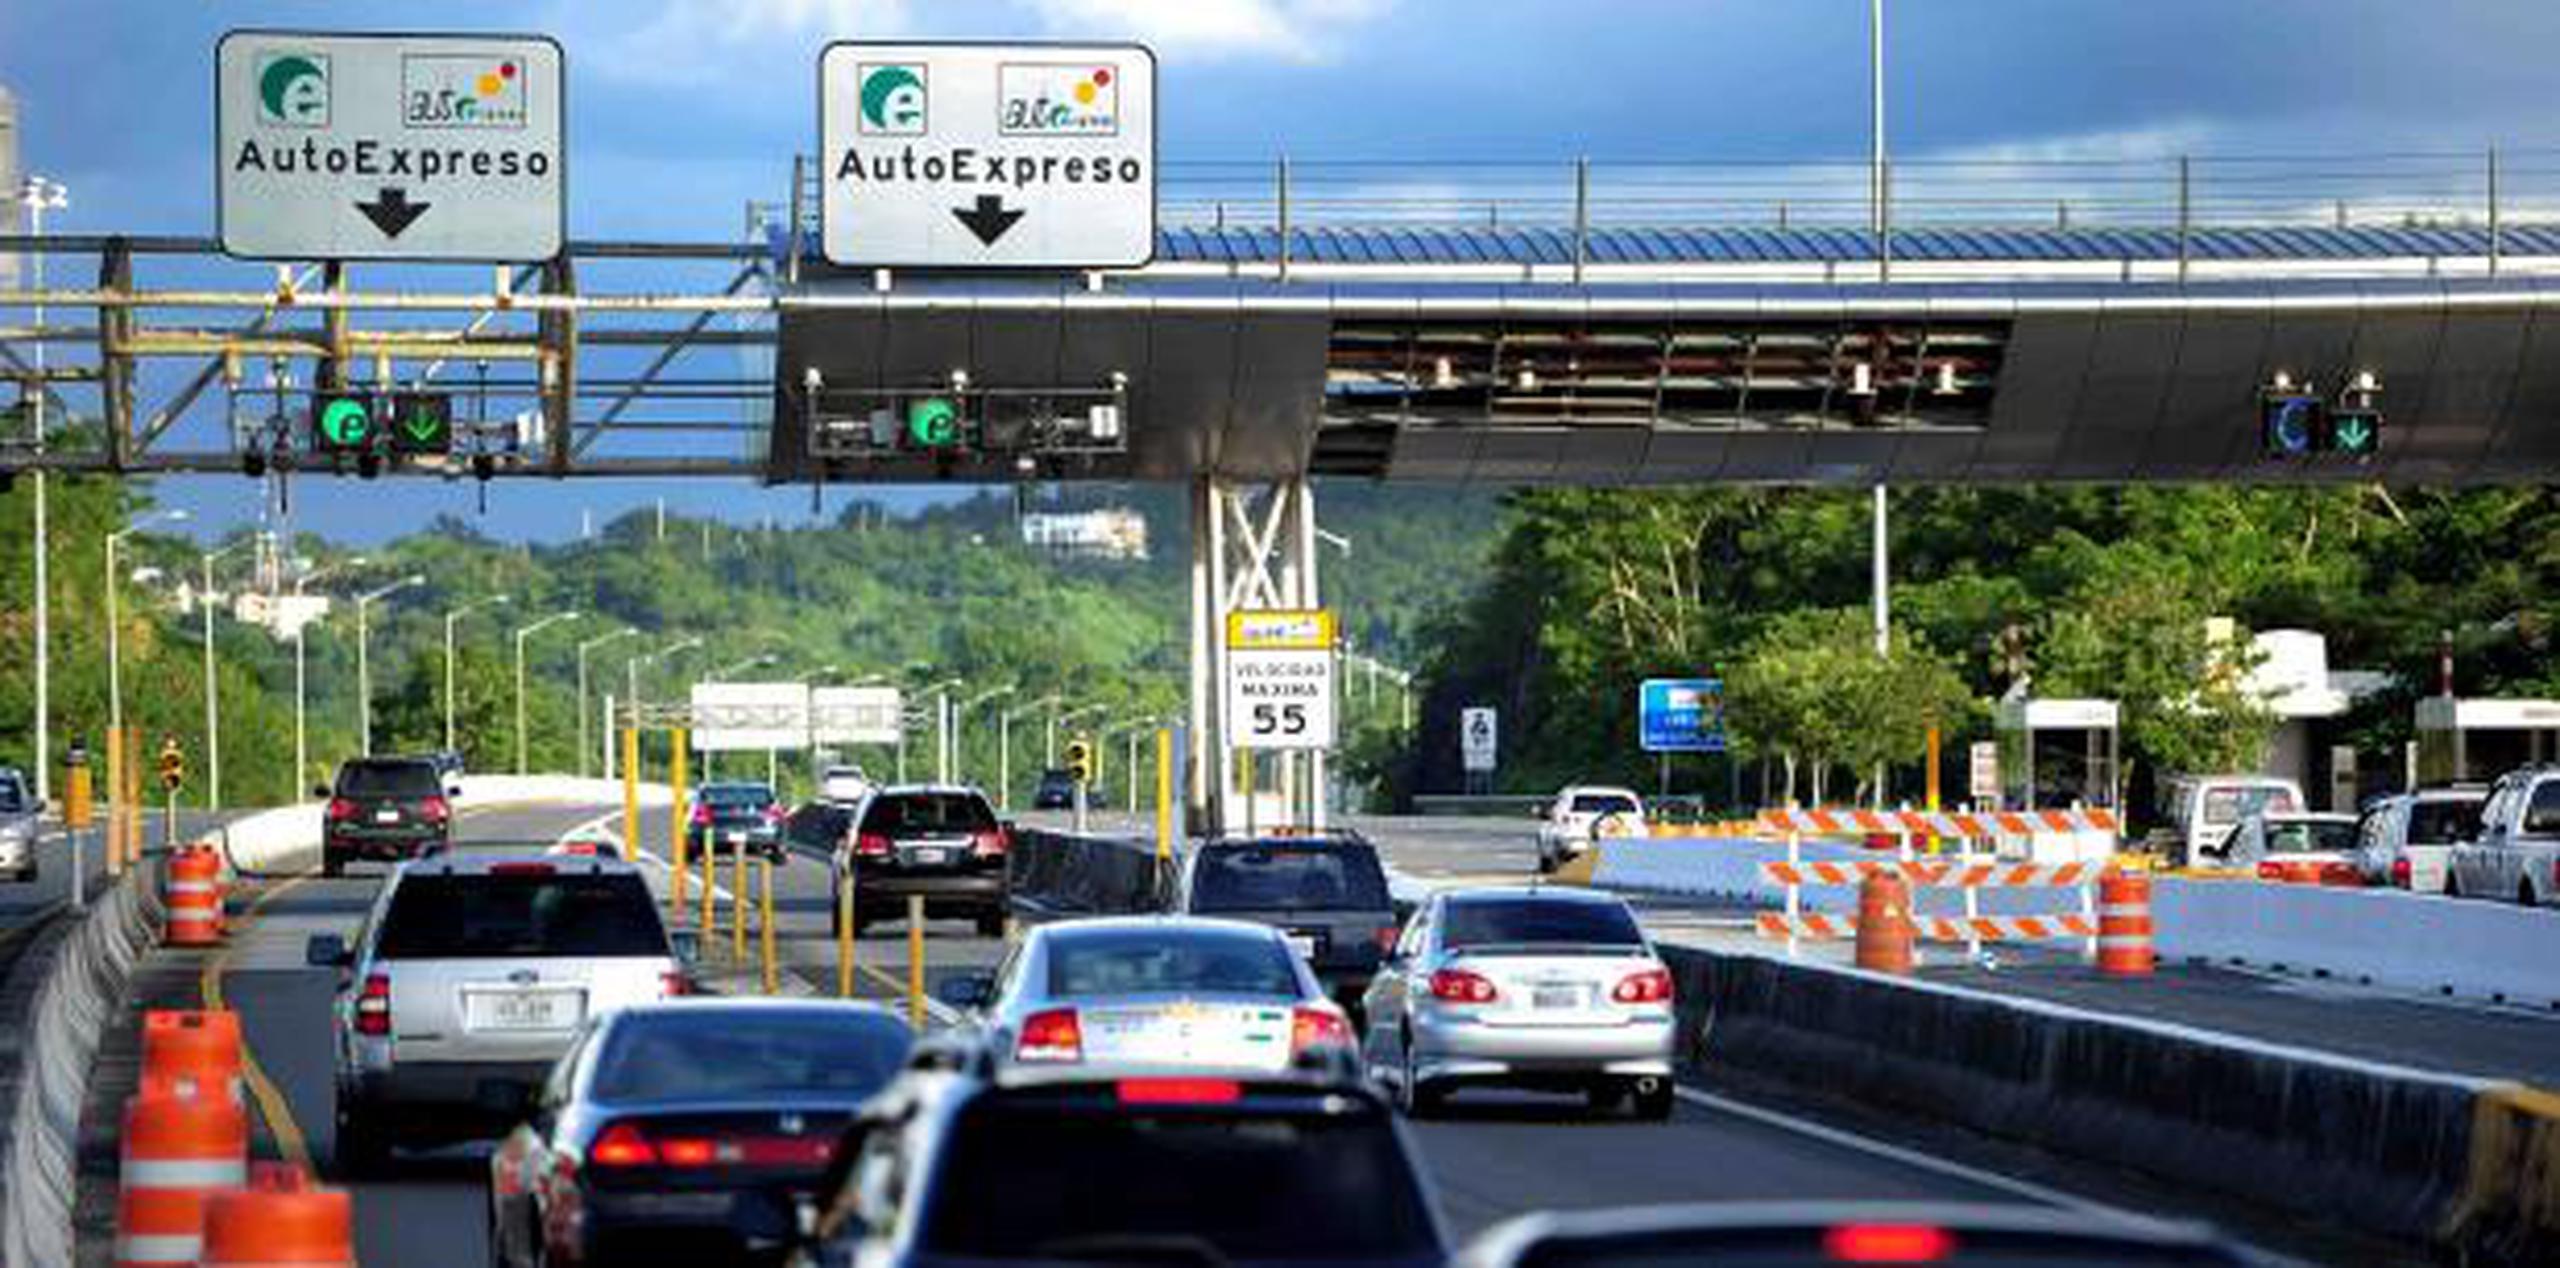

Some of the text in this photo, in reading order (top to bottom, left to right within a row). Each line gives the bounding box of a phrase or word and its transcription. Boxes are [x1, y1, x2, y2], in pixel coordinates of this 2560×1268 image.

[235, 136, 549, 182] AutoExpreso
[837, 146, 1141, 189] AutoExpreso
[1235, 662, 1326, 677] VELOCIDAD
[1242, 683, 1319, 697] MAXIMA
[1253, 703, 1307, 735] 55
